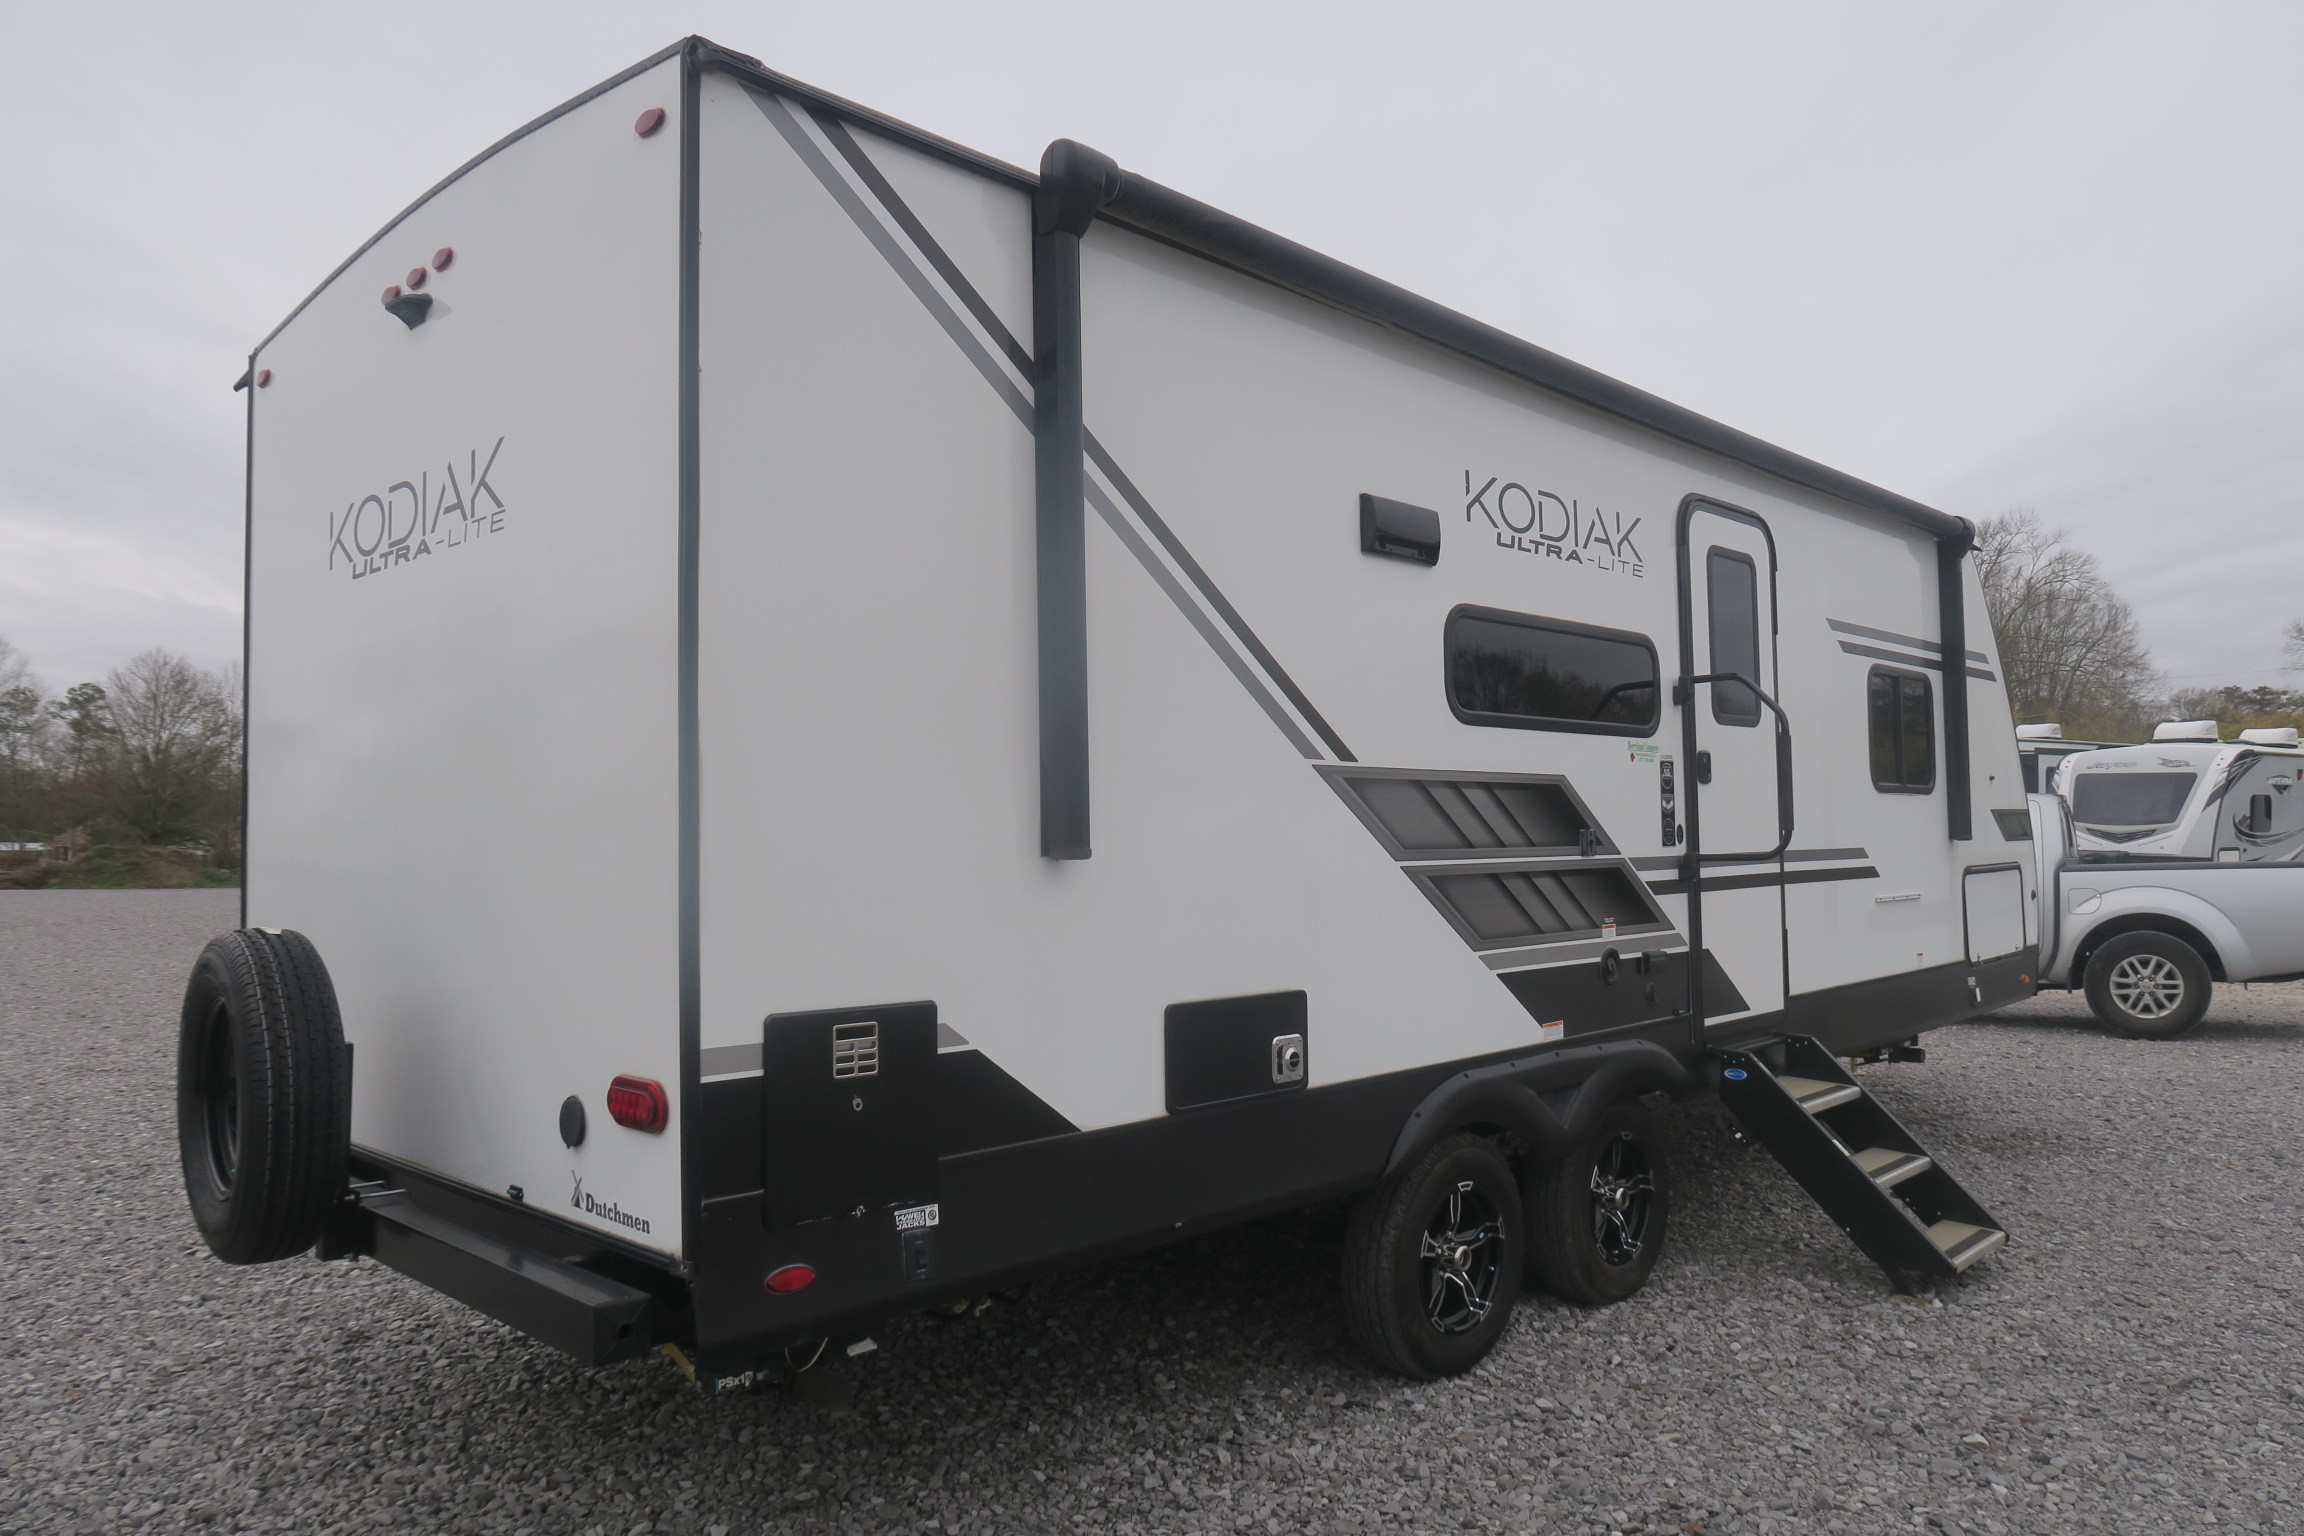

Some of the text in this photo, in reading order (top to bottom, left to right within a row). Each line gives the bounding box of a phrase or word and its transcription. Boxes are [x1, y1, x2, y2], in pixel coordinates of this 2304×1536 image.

[330, 436, 505, 570] KODIAK
[1464, 469, 1643, 562] KODIAK
[352, 509, 506, 580] ULTRA-LITE
[1496, 531, 1644, 578] ULTRA-LITE
[585, 1192, 651, 1234] Dutchmen
